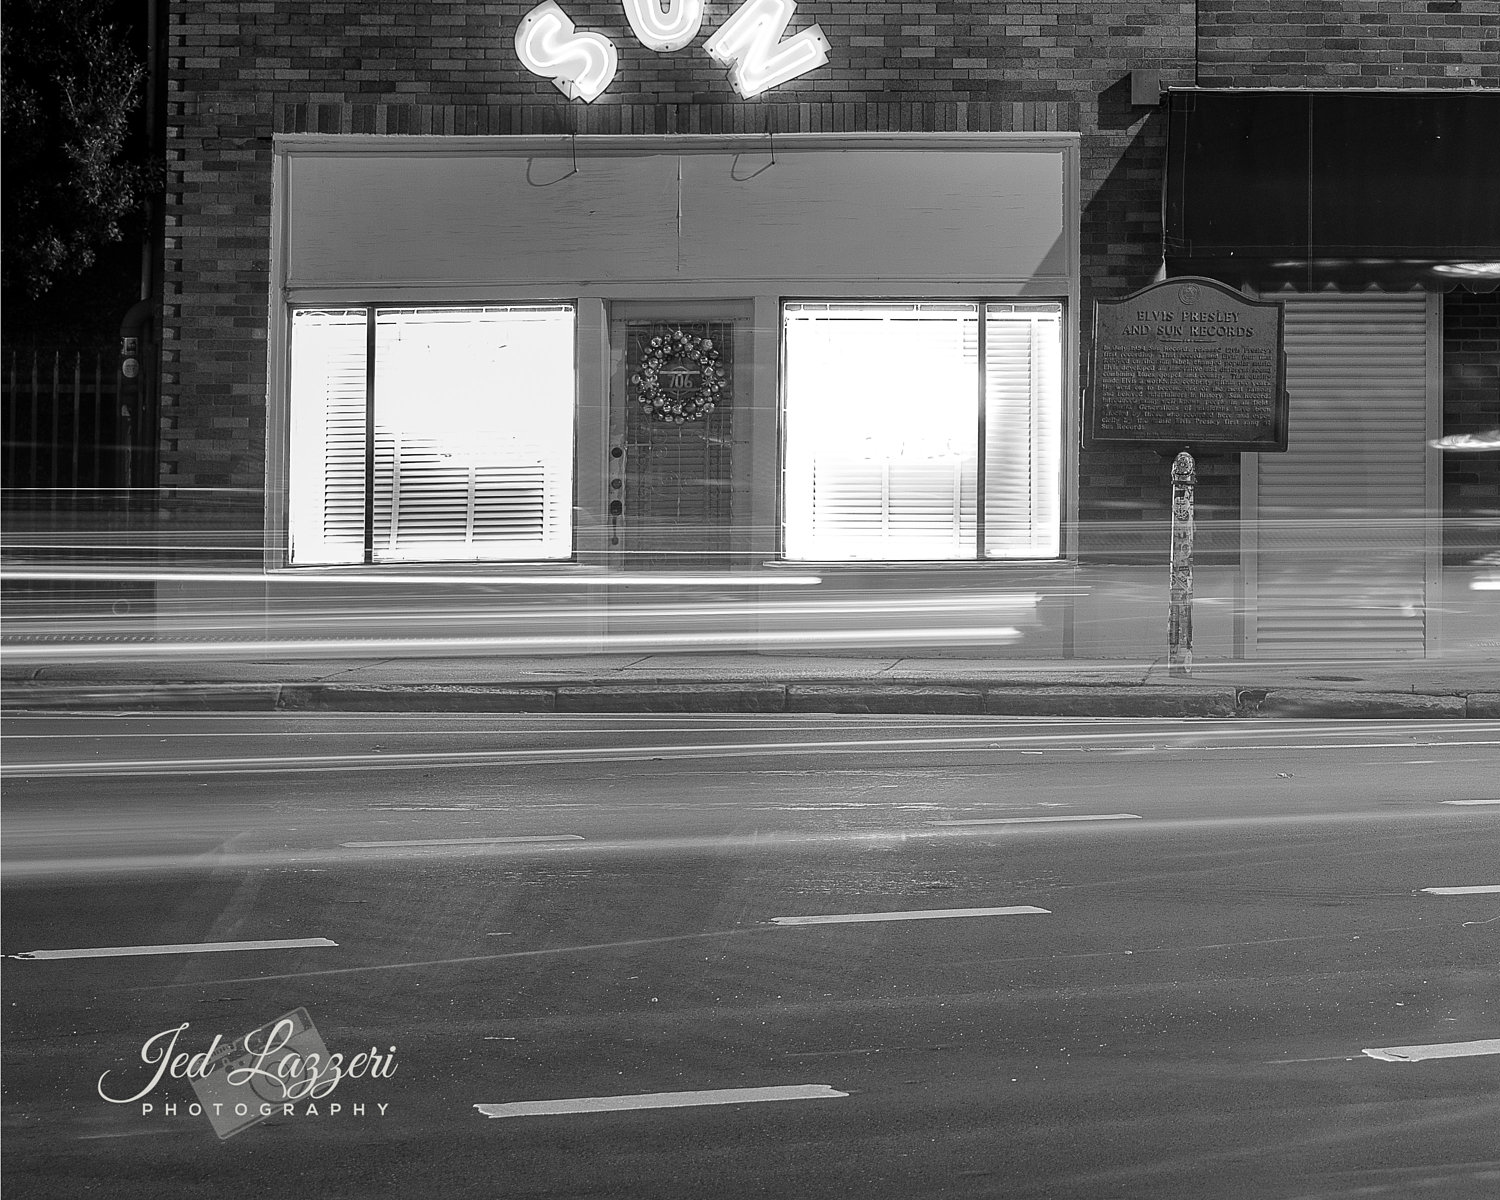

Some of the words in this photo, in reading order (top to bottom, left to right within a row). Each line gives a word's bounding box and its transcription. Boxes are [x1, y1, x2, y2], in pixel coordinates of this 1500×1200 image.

[1137, 311, 1174, 321] ELVIS
[1181, 311, 1239, 322] PRESLEY
[1122, 325, 1151, 335] AND
[1157, 326, 1183, 336] SUN
[1190, 326, 1254, 337] RECORDS
[668, 373, 693, 388] 706
